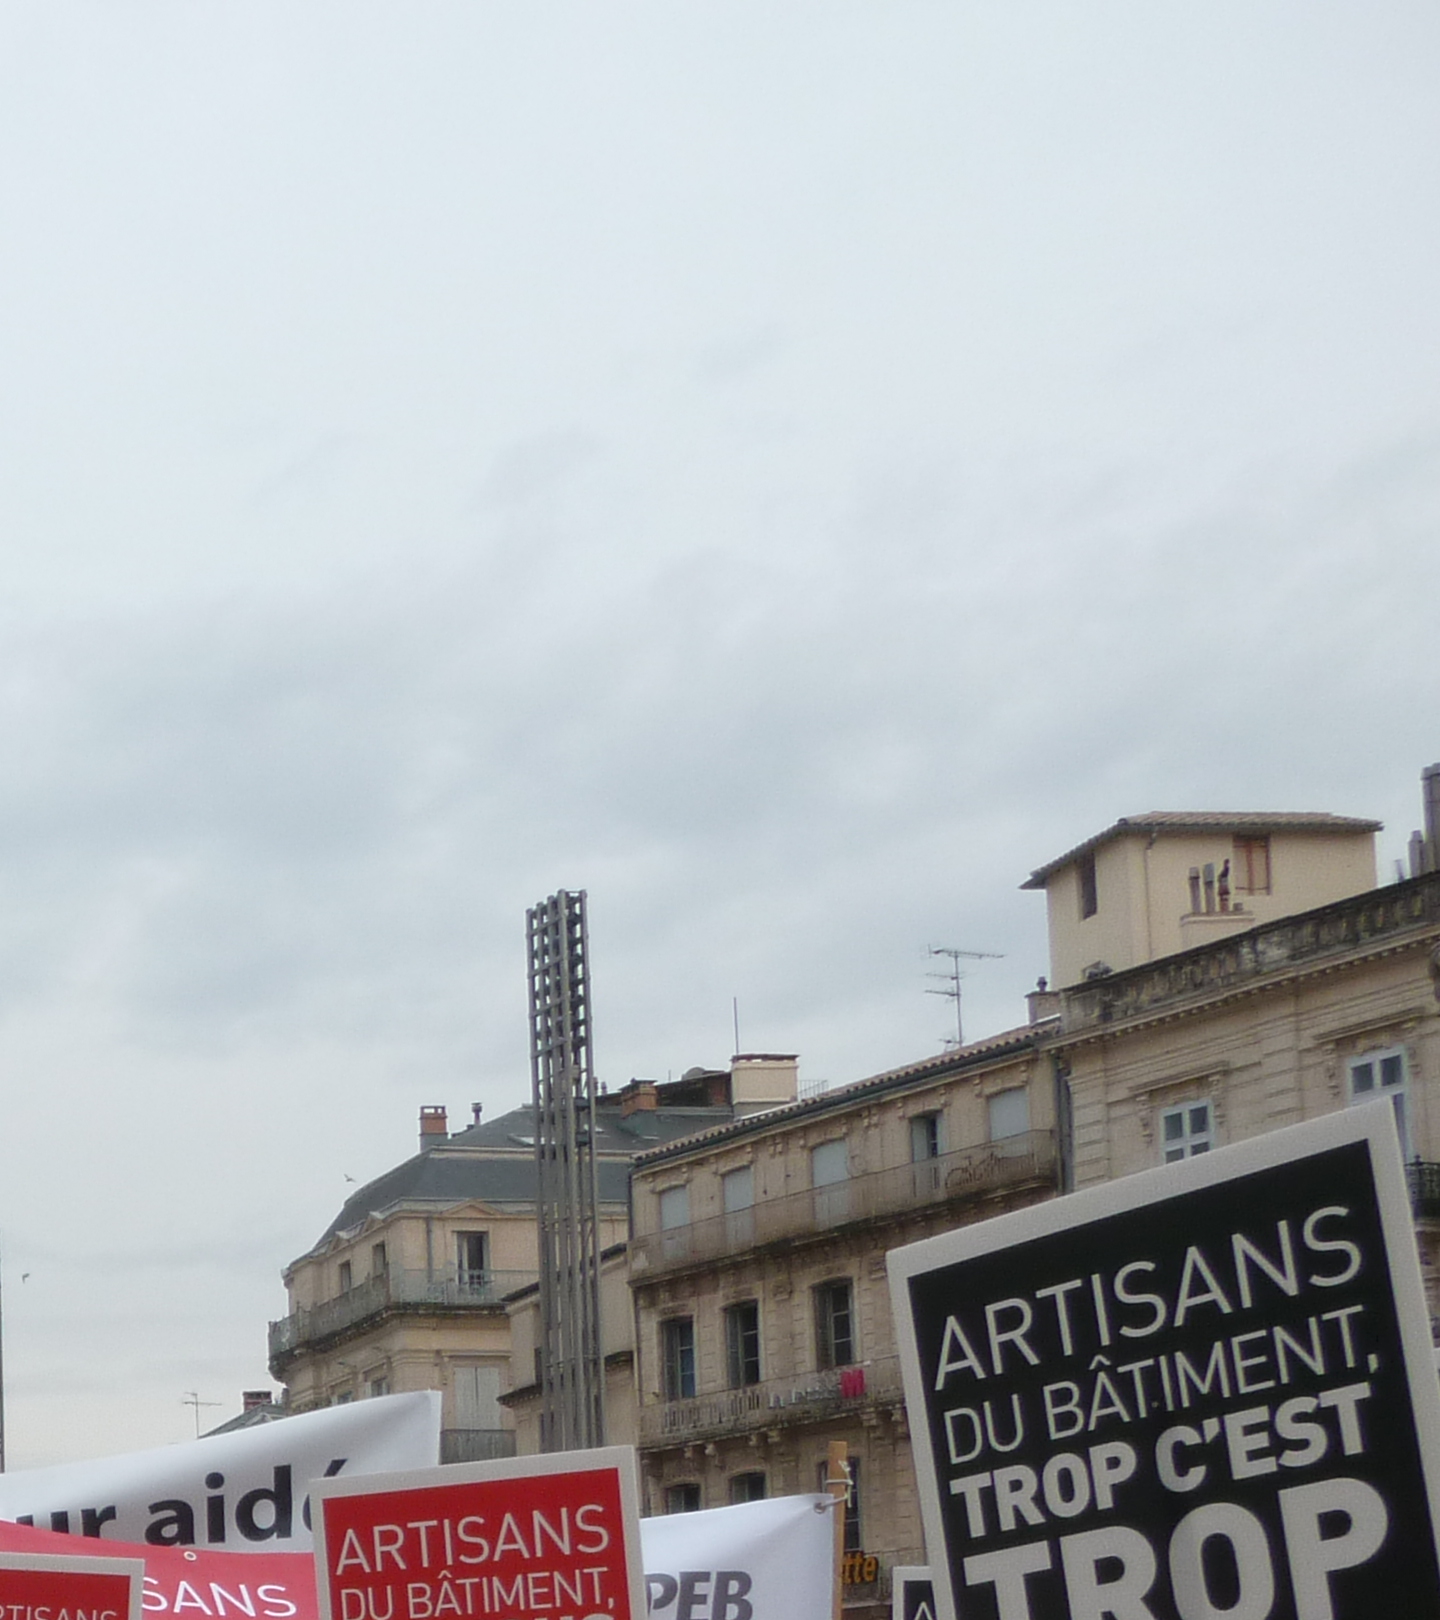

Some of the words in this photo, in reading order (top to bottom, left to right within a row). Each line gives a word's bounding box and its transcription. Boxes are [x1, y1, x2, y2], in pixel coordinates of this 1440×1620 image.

[934, 1206, 1362, 1391] ARTISANS
[943, 1394, 1025, 1465] DU
[1043, 1304, 1380, 1442] BÂTIMENT,
[949, 1441, 1137, 1539] TROP
[1155, 1381, 1372, 1493] C'EST
[336, 1504, 610, 1576] ARTISANS
[406, 1566, 615, 1620] BÂTIMENT,
